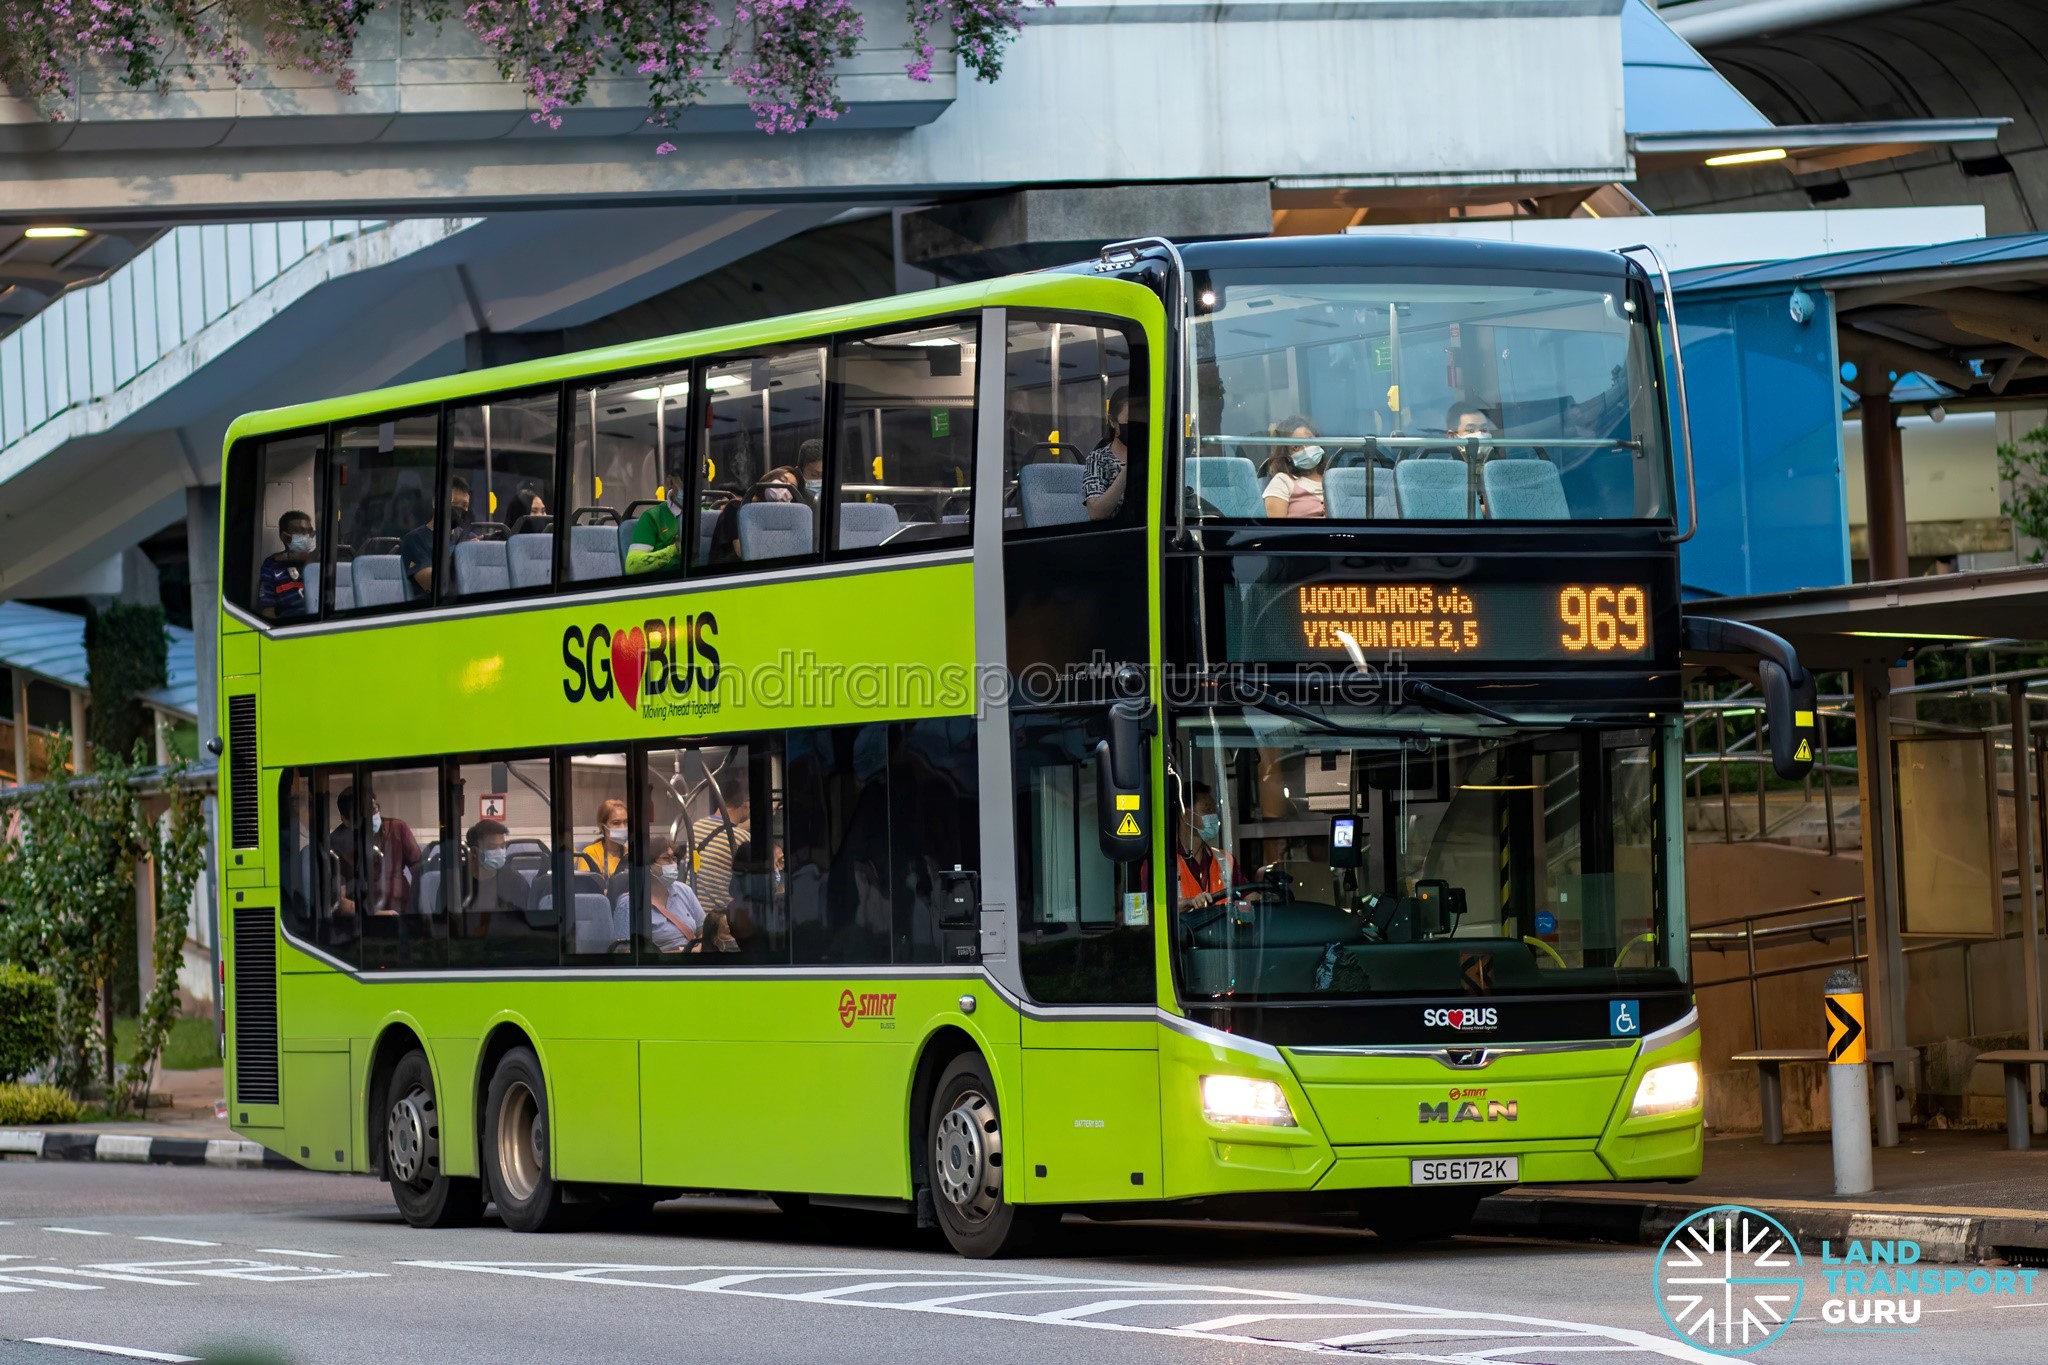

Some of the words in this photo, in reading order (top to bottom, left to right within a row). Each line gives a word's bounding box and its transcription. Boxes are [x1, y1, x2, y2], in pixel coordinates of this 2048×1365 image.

[1300, 586, 1433, 614] WOODLANDS
[1437, 587, 1473, 614] via
[1559, 586, 1646, 651] 969
[1303, 620, 1387, 648] YISHUN
[1391, 620, 1435, 648] AVE
[642, 703, 667, 721] Moving
[668, 700, 690, 717] Ahead
[691, 700, 721, 719] Together
[857, 993, 897, 1016] SMRT
[1461, 1088, 1488, 1097] SMRT
[1418, 1100, 1518, 1123] MAN
[1423, 1159, 1507, 1181] SG6172K
